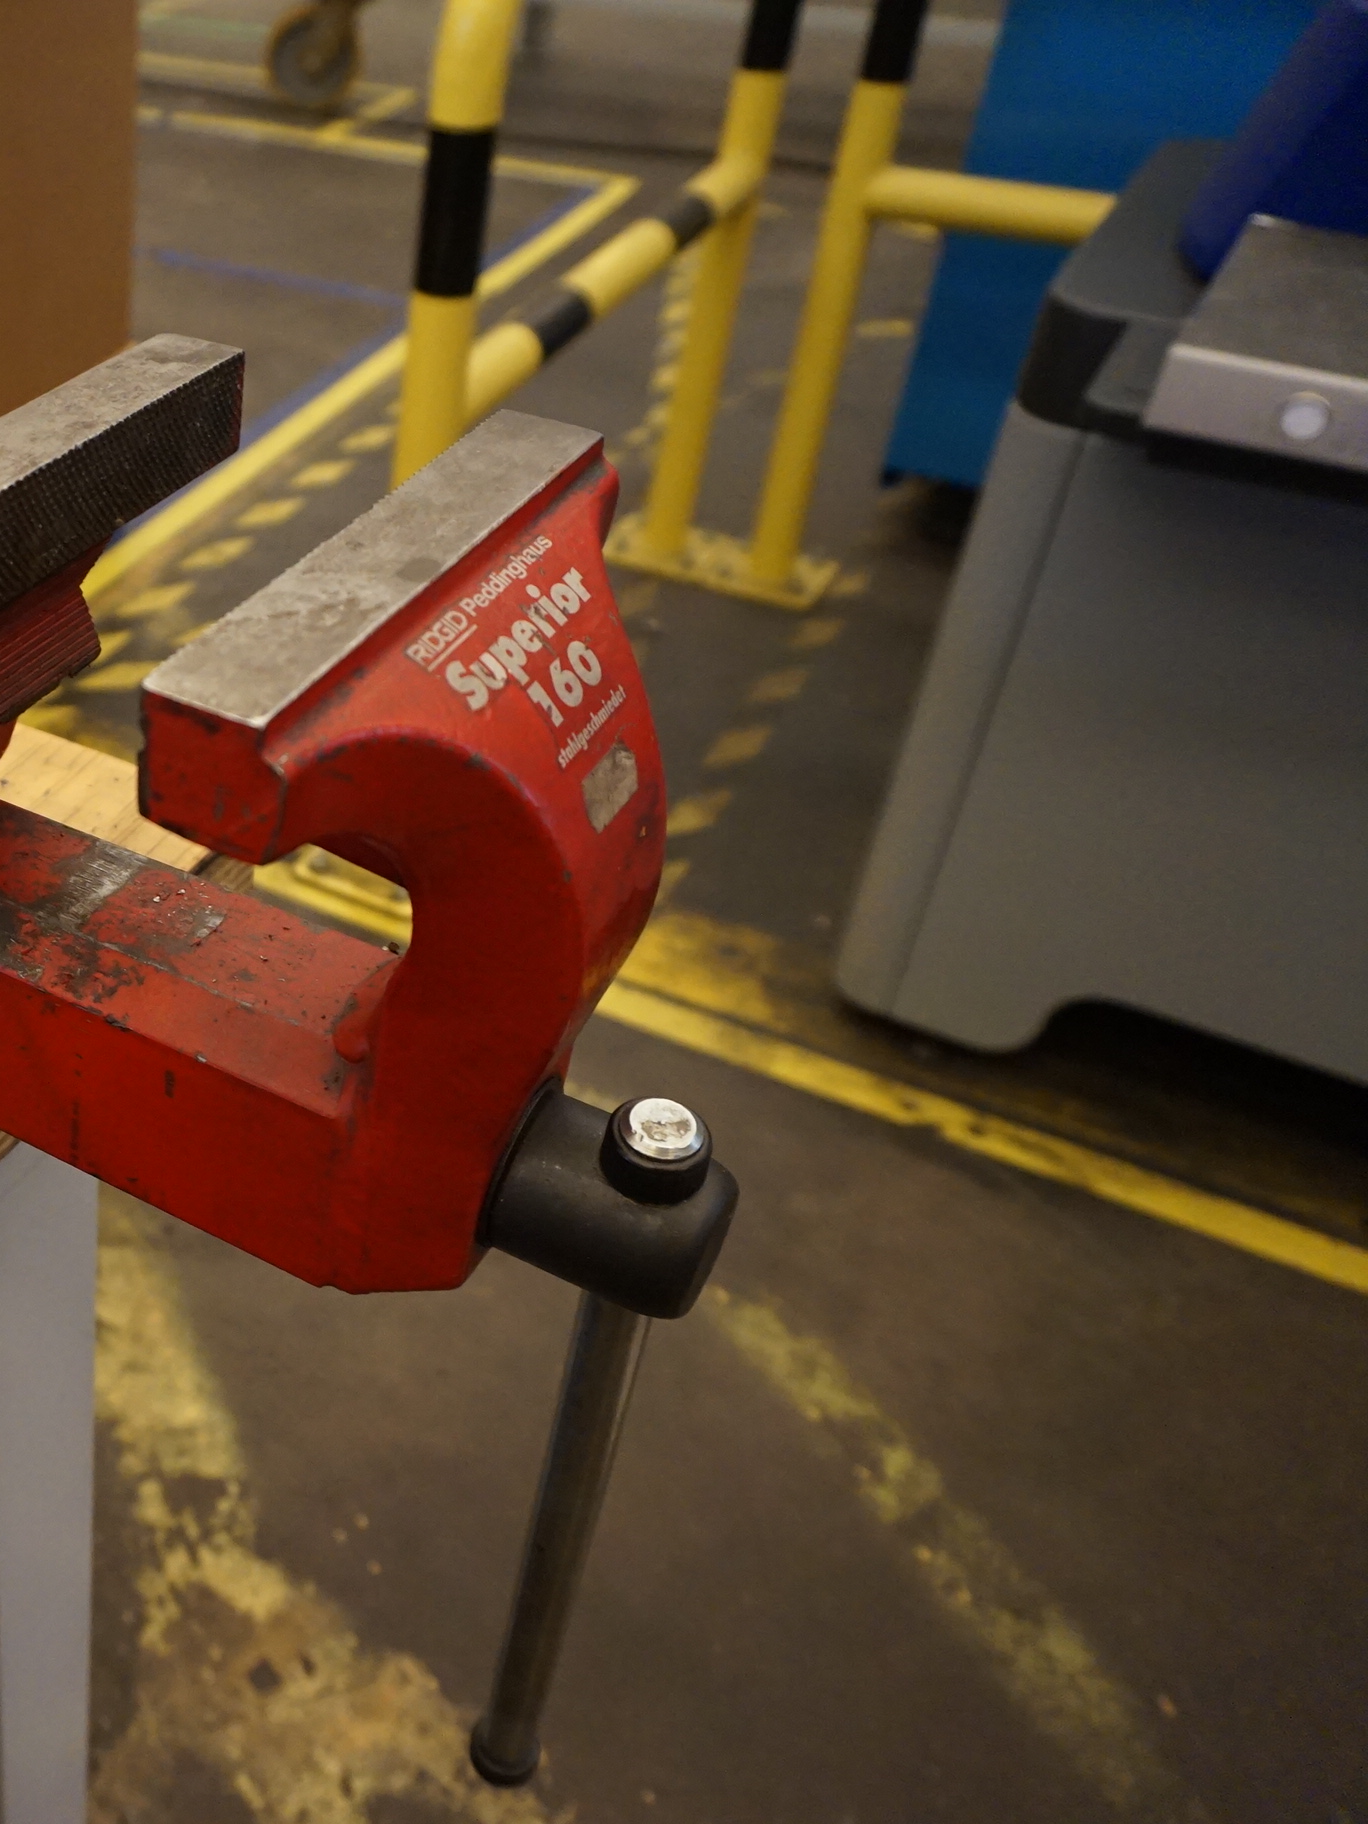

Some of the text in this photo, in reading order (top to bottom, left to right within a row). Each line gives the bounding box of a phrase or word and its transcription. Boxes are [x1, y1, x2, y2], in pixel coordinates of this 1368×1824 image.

[405, 535, 553, 666] RIDGID Peddinghaus
[445, 567, 592, 711] Superior
[527, 640, 603, 728] 160
[557, 684, 628, 770] stahlgeschmiedet
